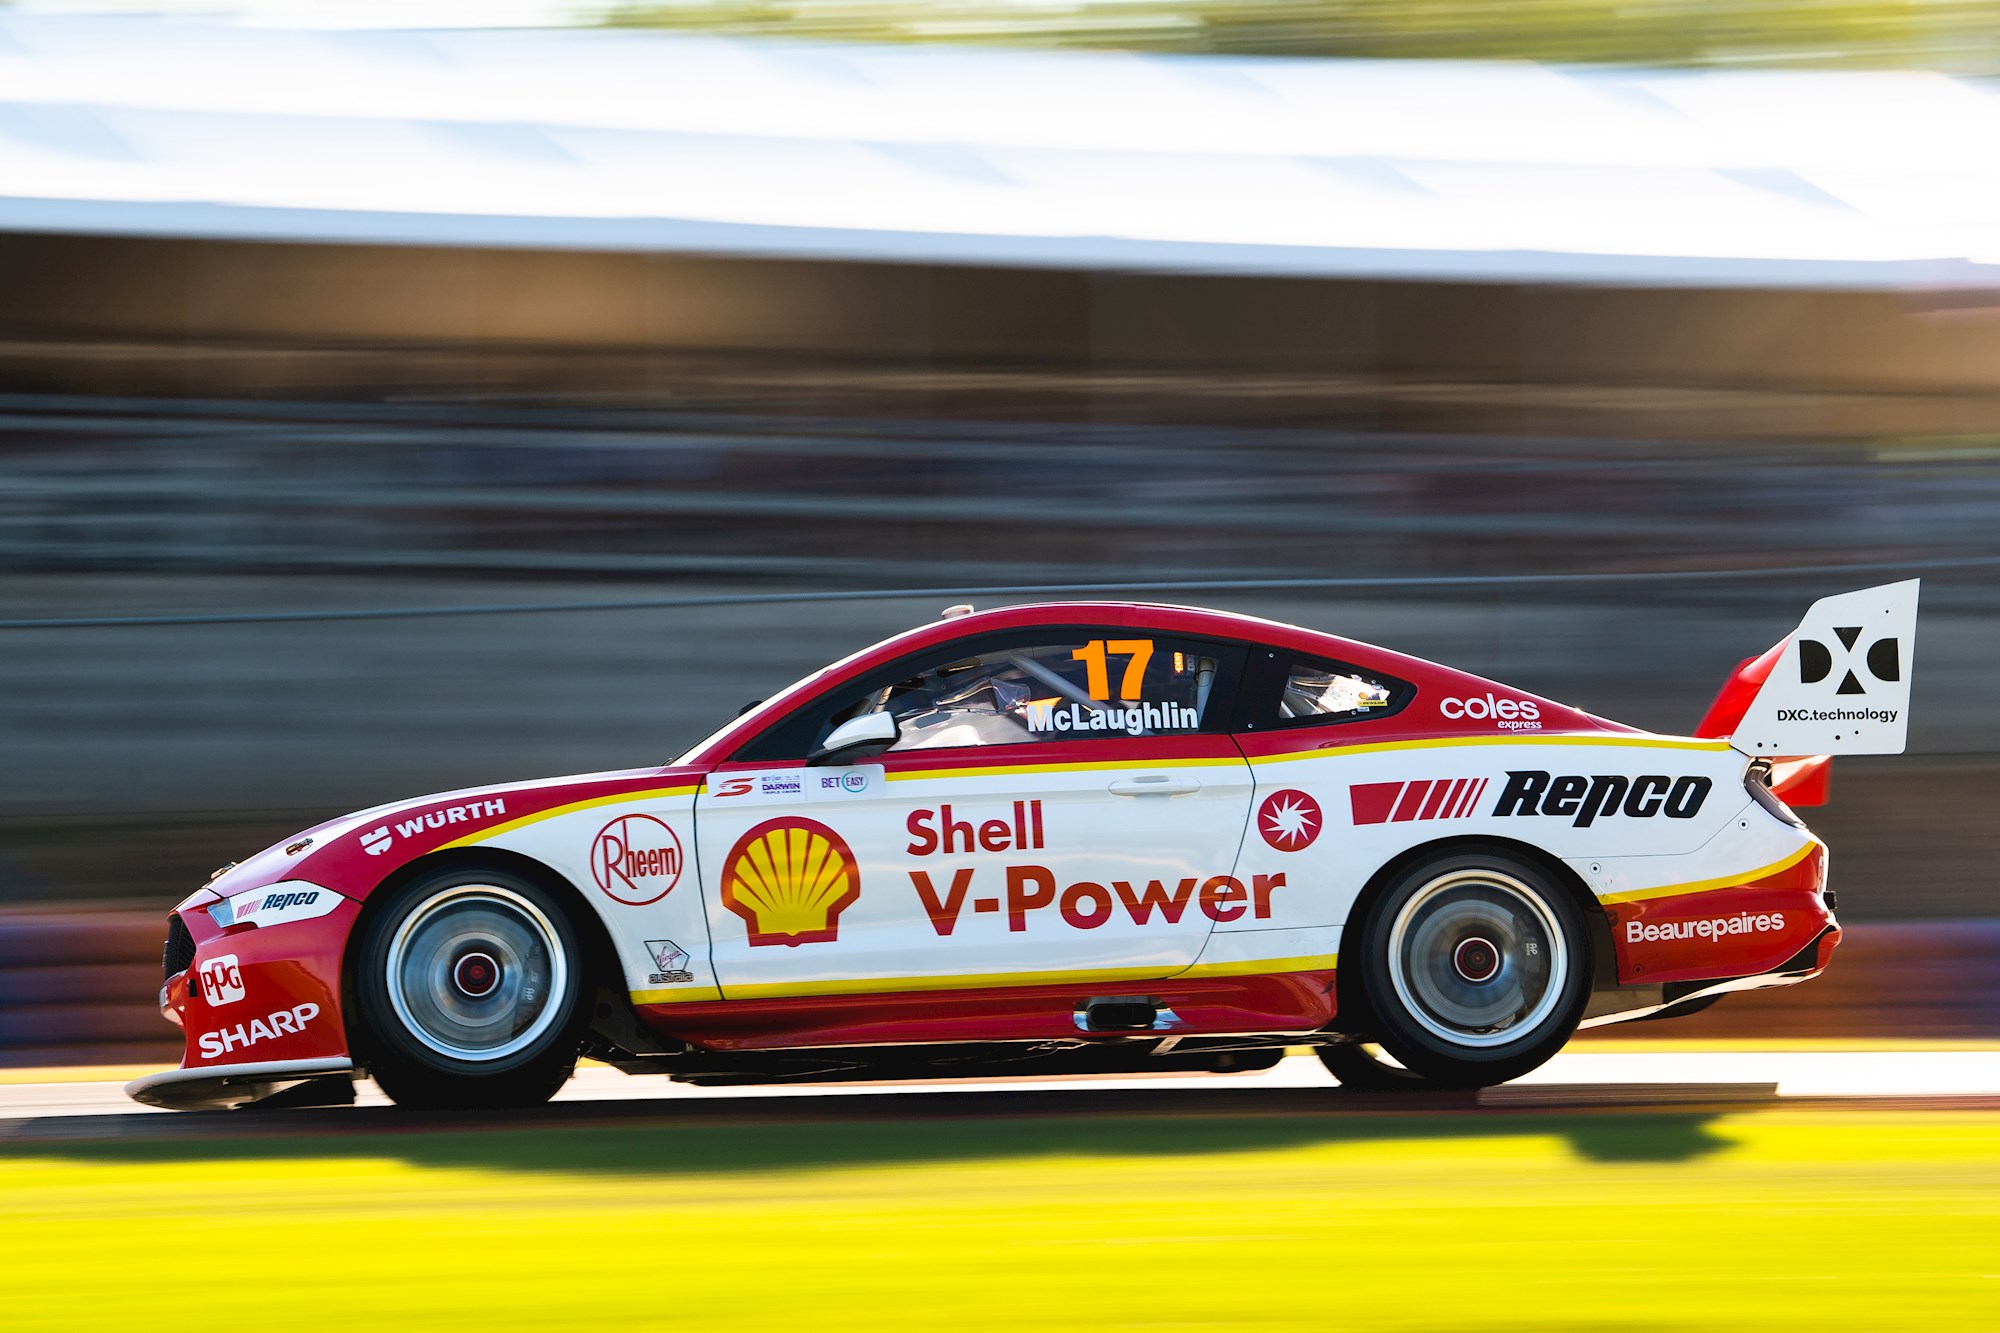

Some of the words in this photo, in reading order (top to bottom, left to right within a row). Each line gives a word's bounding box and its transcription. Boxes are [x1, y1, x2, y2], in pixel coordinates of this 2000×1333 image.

[1072, 639, 1154, 701] 17
[1027, 701, 1198, 736] McLaughlin
[1440, 693, 1540, 720] coles
[1777, 707, 1899, 723] DXC.technology
[1497, 720, 1542, 732] express
[762, 782, 801, 791] DARWIN
[821, 777, 840, 789] BET
[1492, 770, 1713, 828] Repco
[395, 799, 506, 838] WÜRTH
[906, 799, 1045, 857] Shell
[601, 819, 677, 890] Rheem
[261, 891, 320, 911] Repco
[908, 865, 1287, 936] V-Power
[1626, 912, 1785, 944] Beaurepaires
[201, 961, 242, 1001] PPG
[198, 1002, 320, 1059] SHARP
